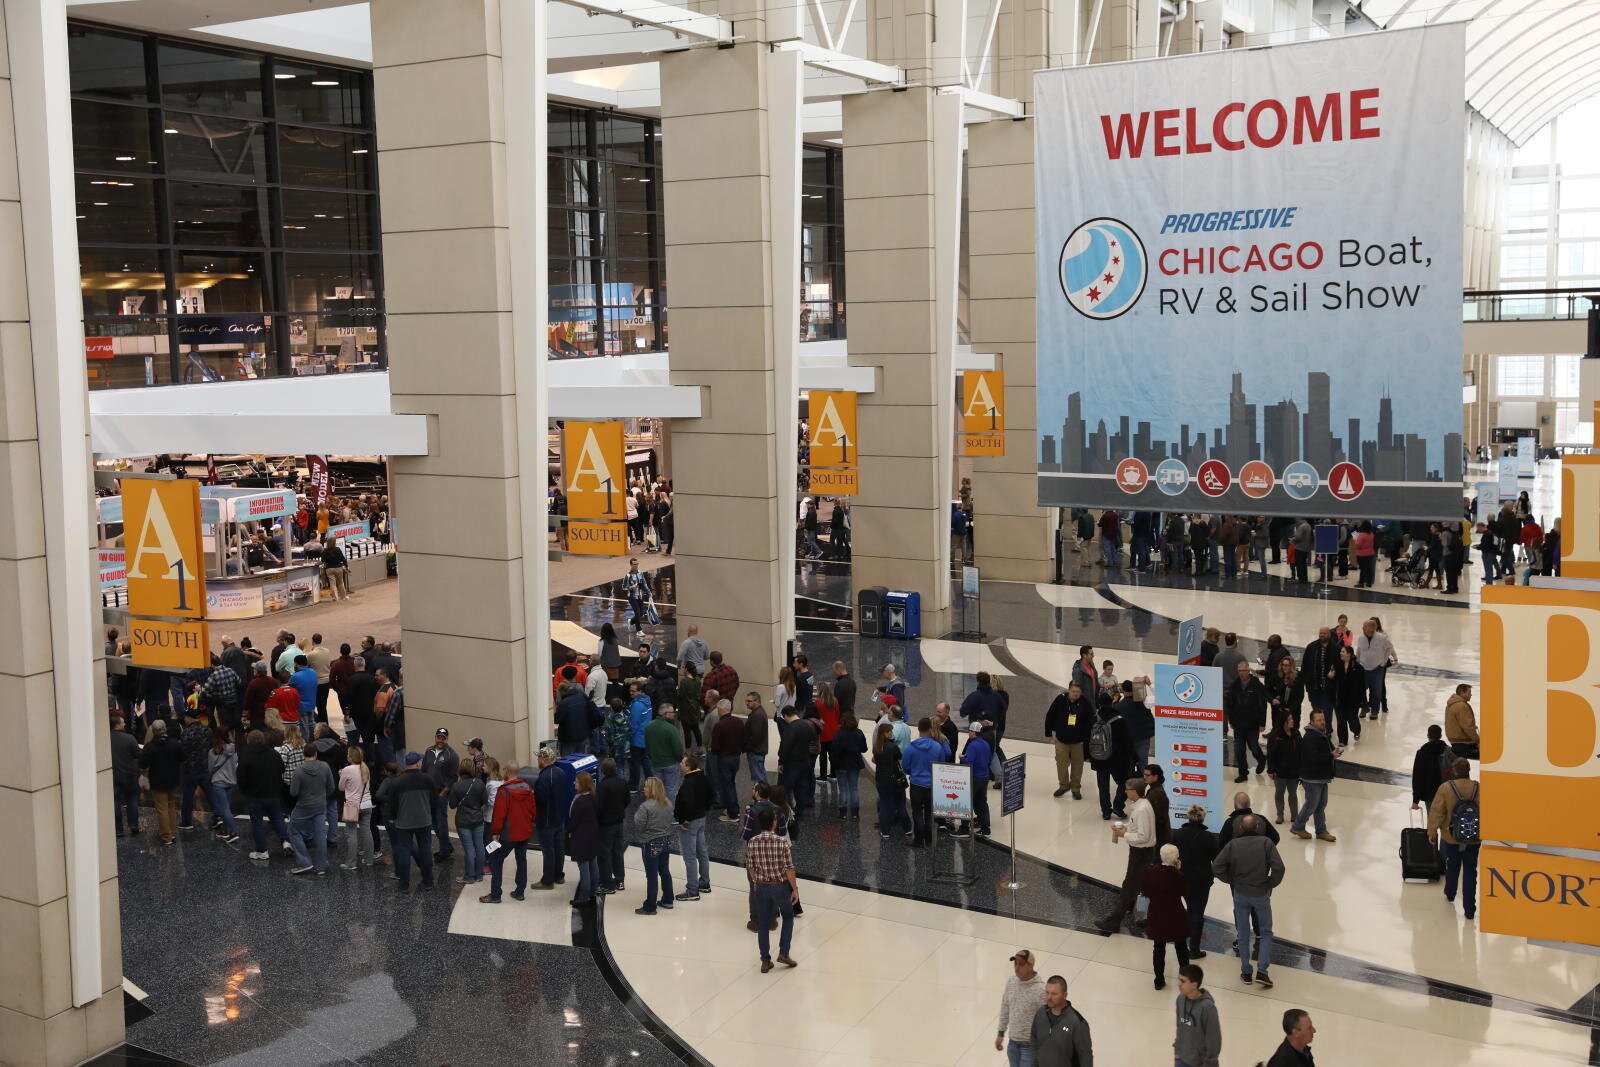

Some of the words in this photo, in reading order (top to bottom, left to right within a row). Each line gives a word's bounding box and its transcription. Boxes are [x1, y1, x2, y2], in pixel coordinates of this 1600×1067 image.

[1100, 88, 1381, 160] WELCOME
[1160, 207, 1298, 234] PROGRESSIVE
[1158, 242, 1325, 276] CHICAGO
[1339, 235, 1432, 268] Boat,
[1159, 287, 1204, 316] RV
[1215, 286, 1238, 314] &
[1250, 282, 1307, 313] Sail
[1321, 280, 1421, 310] Show
[966, 438, 1001, 448] SOUTH
[311, 462, 320, 487] NEW
[812, 474, 854, 485] SOUTH
[250, 495, 284, 508] INFORMATION
[250, 506, 266, 515] SHOW
[266, 503, 284, 513] GUIDES
[571, 527, 621, 542] SOUTH
[133, 628, 199, 649] SOUTH
[1178, 710, 1217, 718] REDEMPTION
